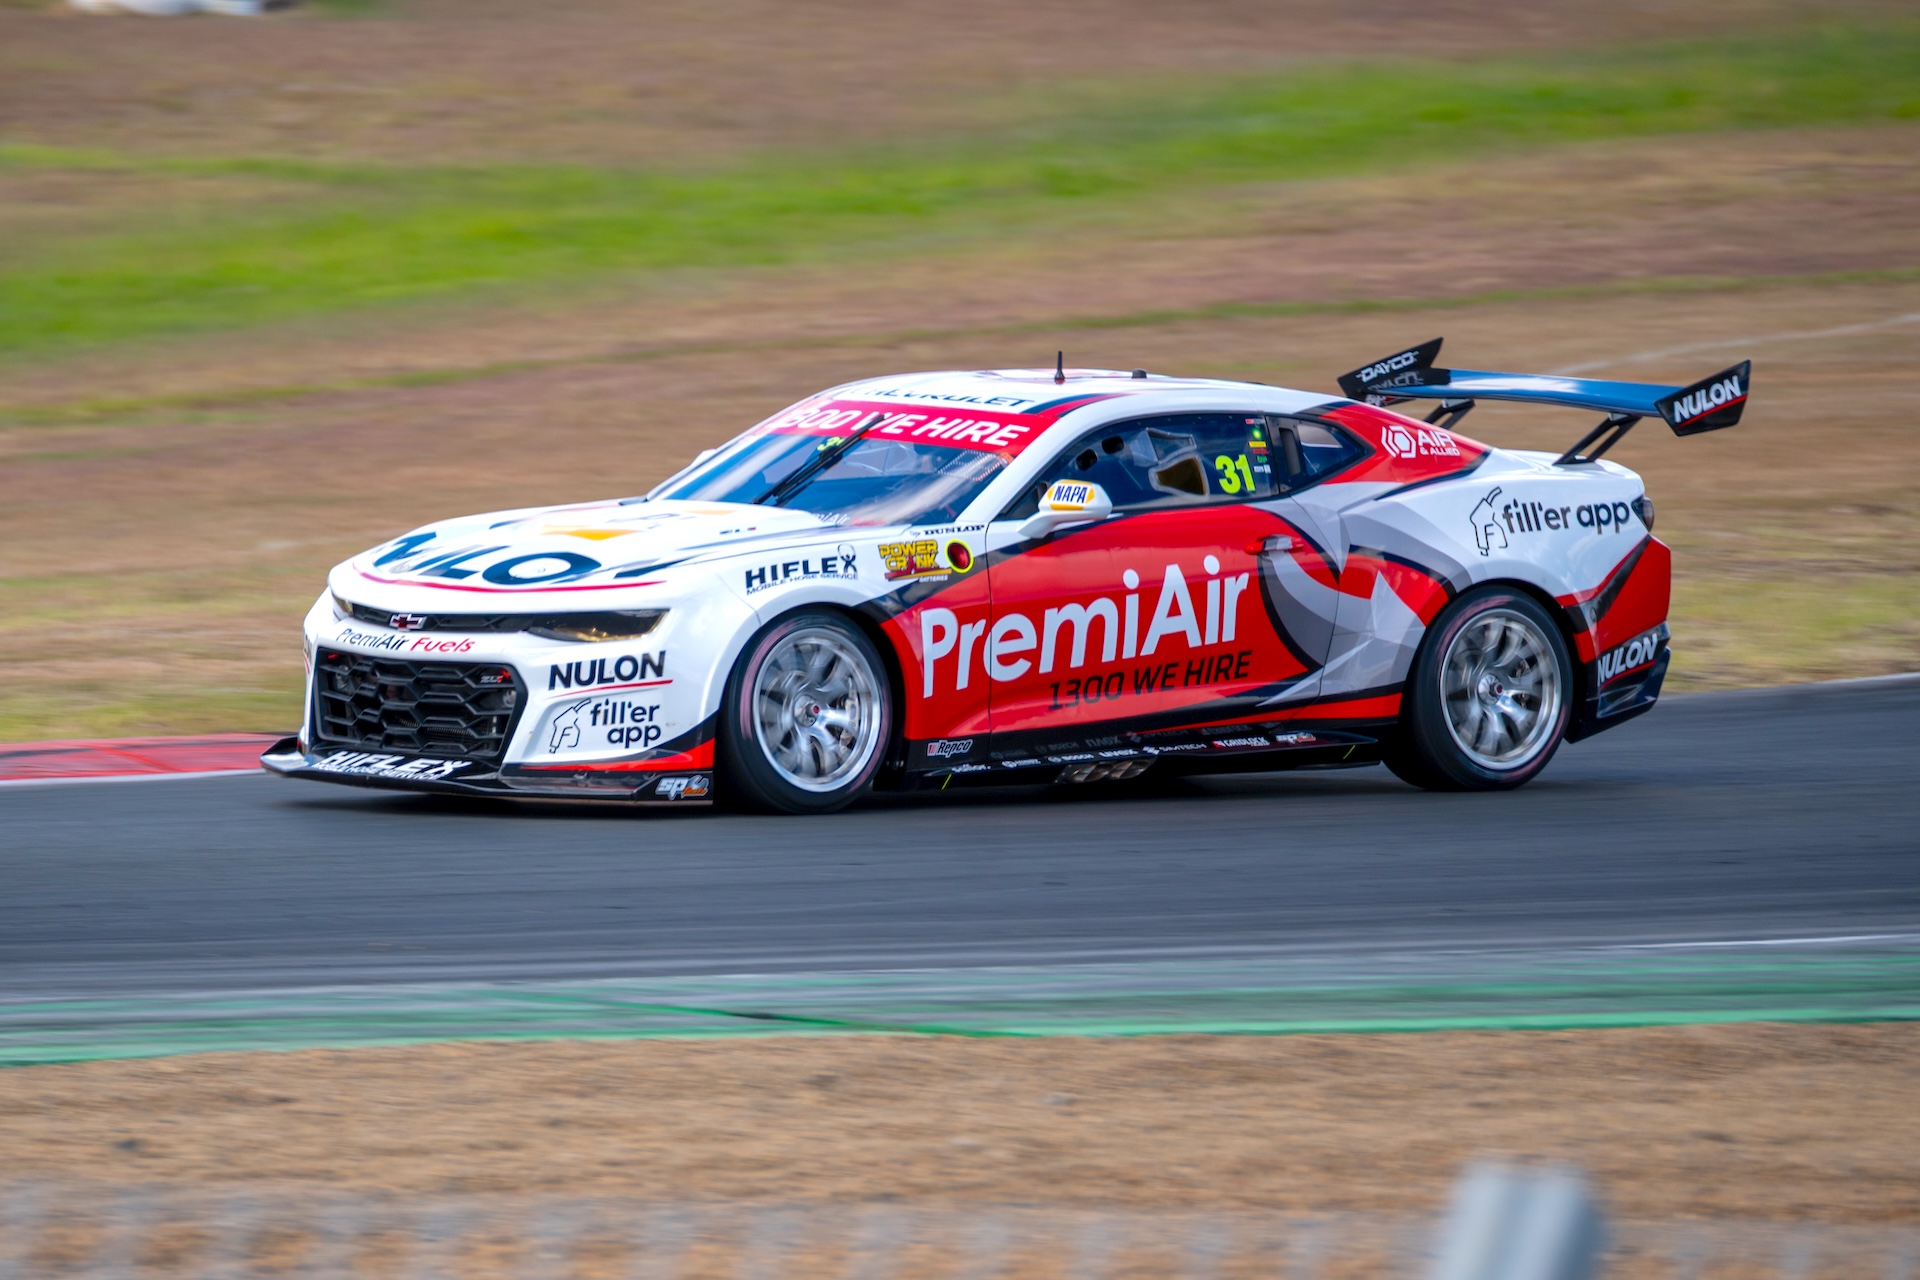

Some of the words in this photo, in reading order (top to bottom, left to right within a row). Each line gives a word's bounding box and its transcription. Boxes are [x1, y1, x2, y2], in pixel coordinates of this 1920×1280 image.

[1356, 351, 1418, 382] DAYCO
[1673, 375, 1742, 423] NULON
[850, 411, 926, 436] WE
[918, 415, 1031, 447] HIRE
[1417, 429, 1456, 447] AIR
[1430, 447, 1460, 456] ALLIED
[1215, 454, 1256, 494] 31
[1053, 485, 1088, 504] NAPA
[923, 525, 985, 536] DUNLOP
[1576, 501, 1630, 535] app
[879, 540, 938, 558] POWER
[745, 544, 858, 588] HIFLEX
[885, 553, 938, 571] CRANK
[746, 579, 786, 596] MOBILE
[790, 573, 817, 582] HOSE
[820, 572, 858, 580] SERVICE
[921, 554, 1249, 698] PremiAir
[336, 628, 409, 650] PremiAir
[410, 637, 476, 652] Fuels
[548, 650, 666, 691] NULON
[1597, 633, 1658, 687] NULON
[1048, 671, 1124, 710] 1300
[1134, 662, 1179, 695] WE
[1184, 650, 1252, 687] HIRE
[607, 725, 661, 749] app
[937, 740, 972, 757] Repco
[320, 751, 472, 776] HIFLEX
